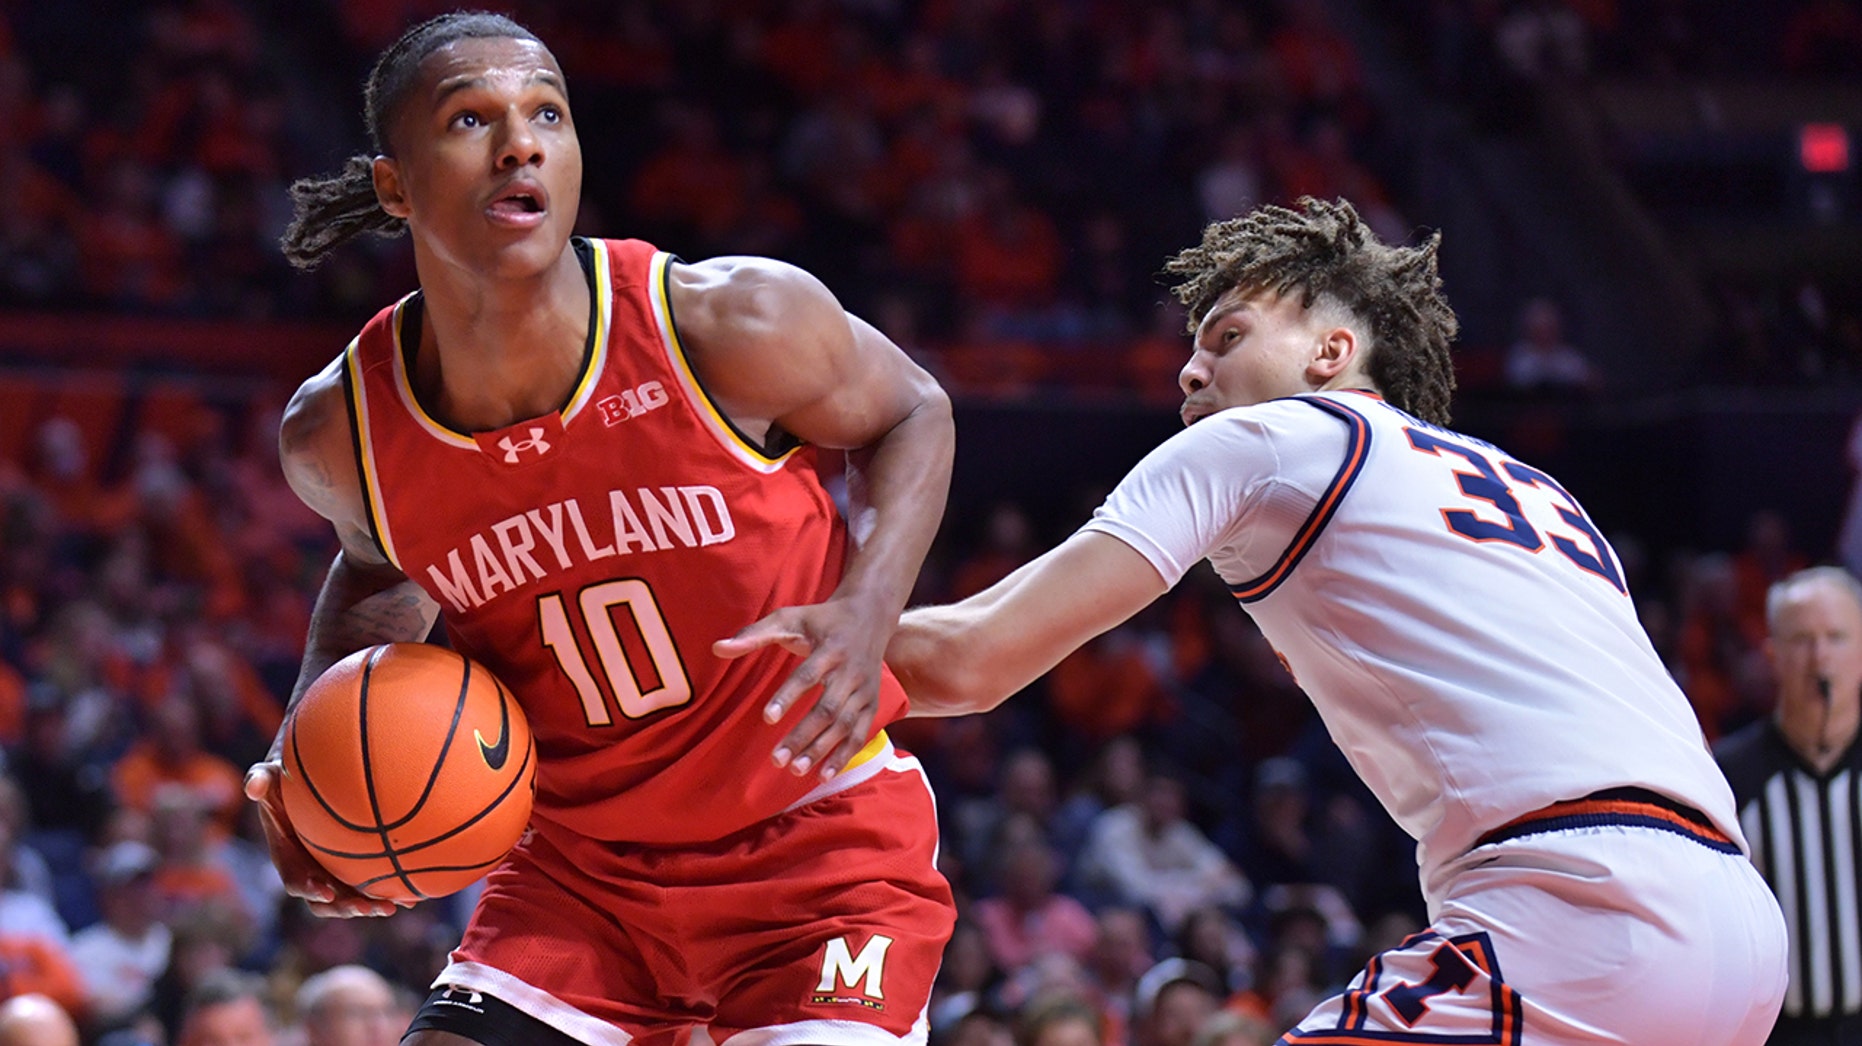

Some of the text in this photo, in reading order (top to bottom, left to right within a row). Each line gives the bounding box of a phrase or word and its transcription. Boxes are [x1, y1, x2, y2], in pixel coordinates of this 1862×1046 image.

[426, 485, 736, 613] MARYLAND
[1402, 426, 1628, 597] 33
[536, 577, 694, 728] 10
[813, 933, 894, 1000] M
